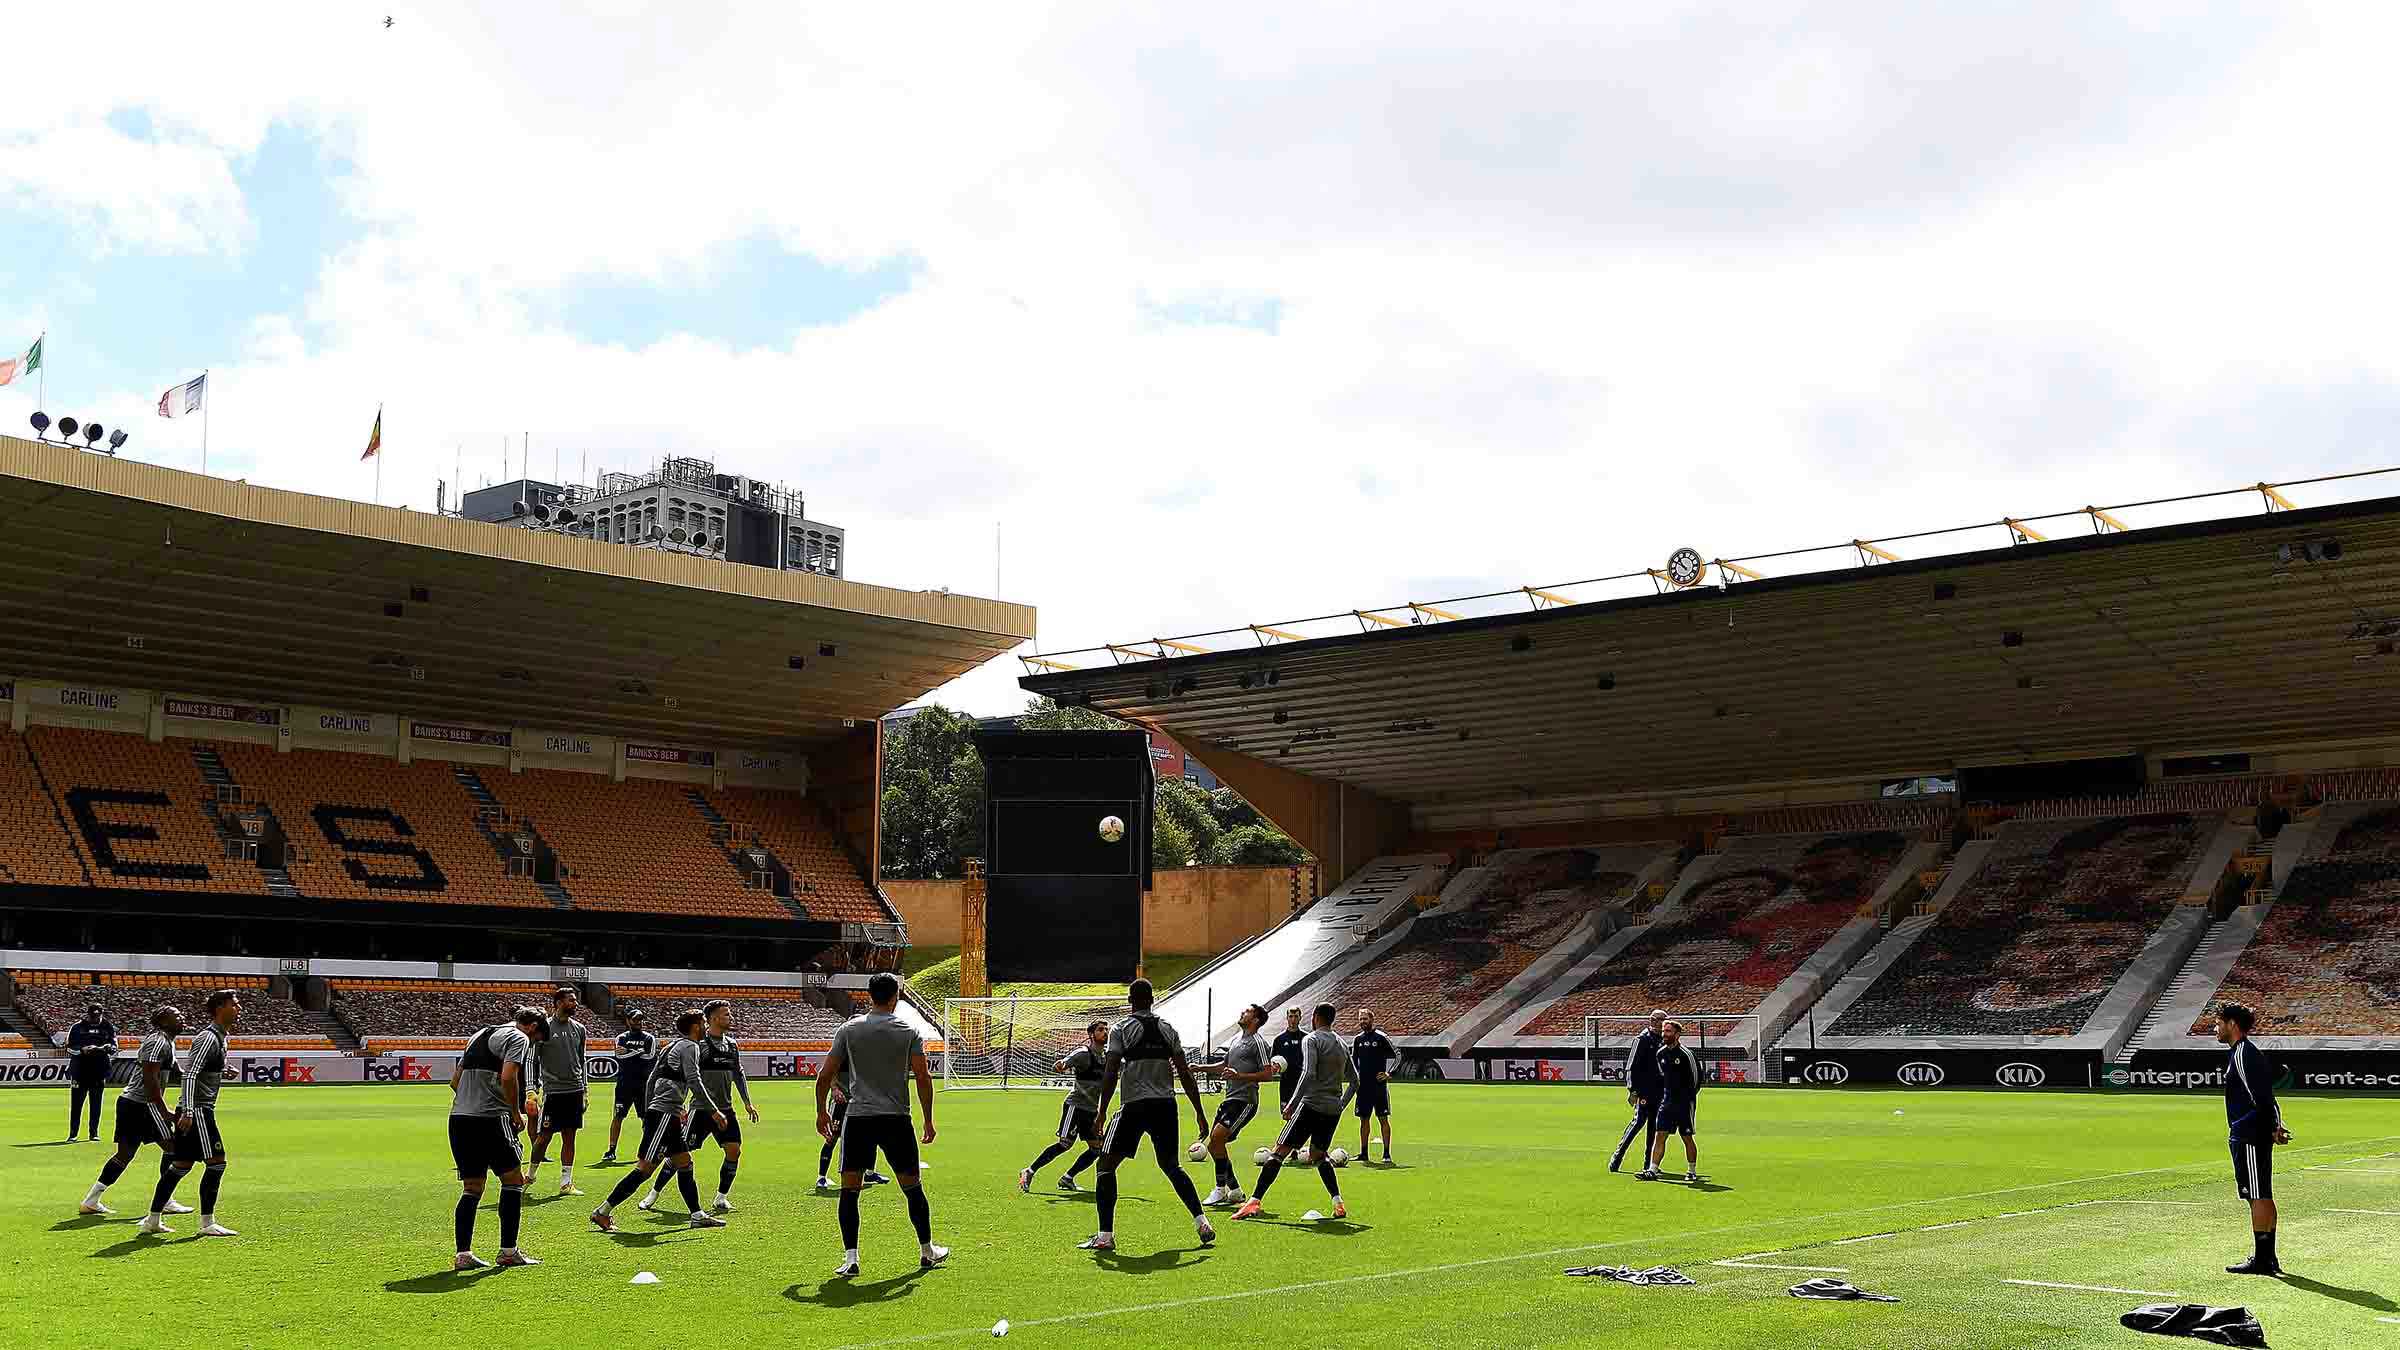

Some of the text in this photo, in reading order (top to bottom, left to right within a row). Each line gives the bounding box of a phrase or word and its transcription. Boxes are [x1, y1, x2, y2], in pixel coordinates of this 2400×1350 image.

[61, 689, 118, 709] CARLING
[169, 702, 208, 716] BANKS'S
[211, 704, 234, 719] BEER
[320, 715, 369, 732] CARLING
[451, 728, 471, 740] BEER
[546, 737, 592, 753] CARLING
[659, 749, 679, 761] BEER
[285, 961, 304, 970] JL8
[242, 1057, 316, 1083] FedEx
[364, 1057, 433, 1081] FedEx
[589, 1062, 613, 1074] KIA
[768, 1056, 819, 1077] FedEx
[1505, 1060, 1564, 1081] FedEx
[1905, 1067, 1937, 1082] KIA
[2004, 1068, 2038, 1083] KIA
[2106, 1067, 2227, 1089] enterpri
